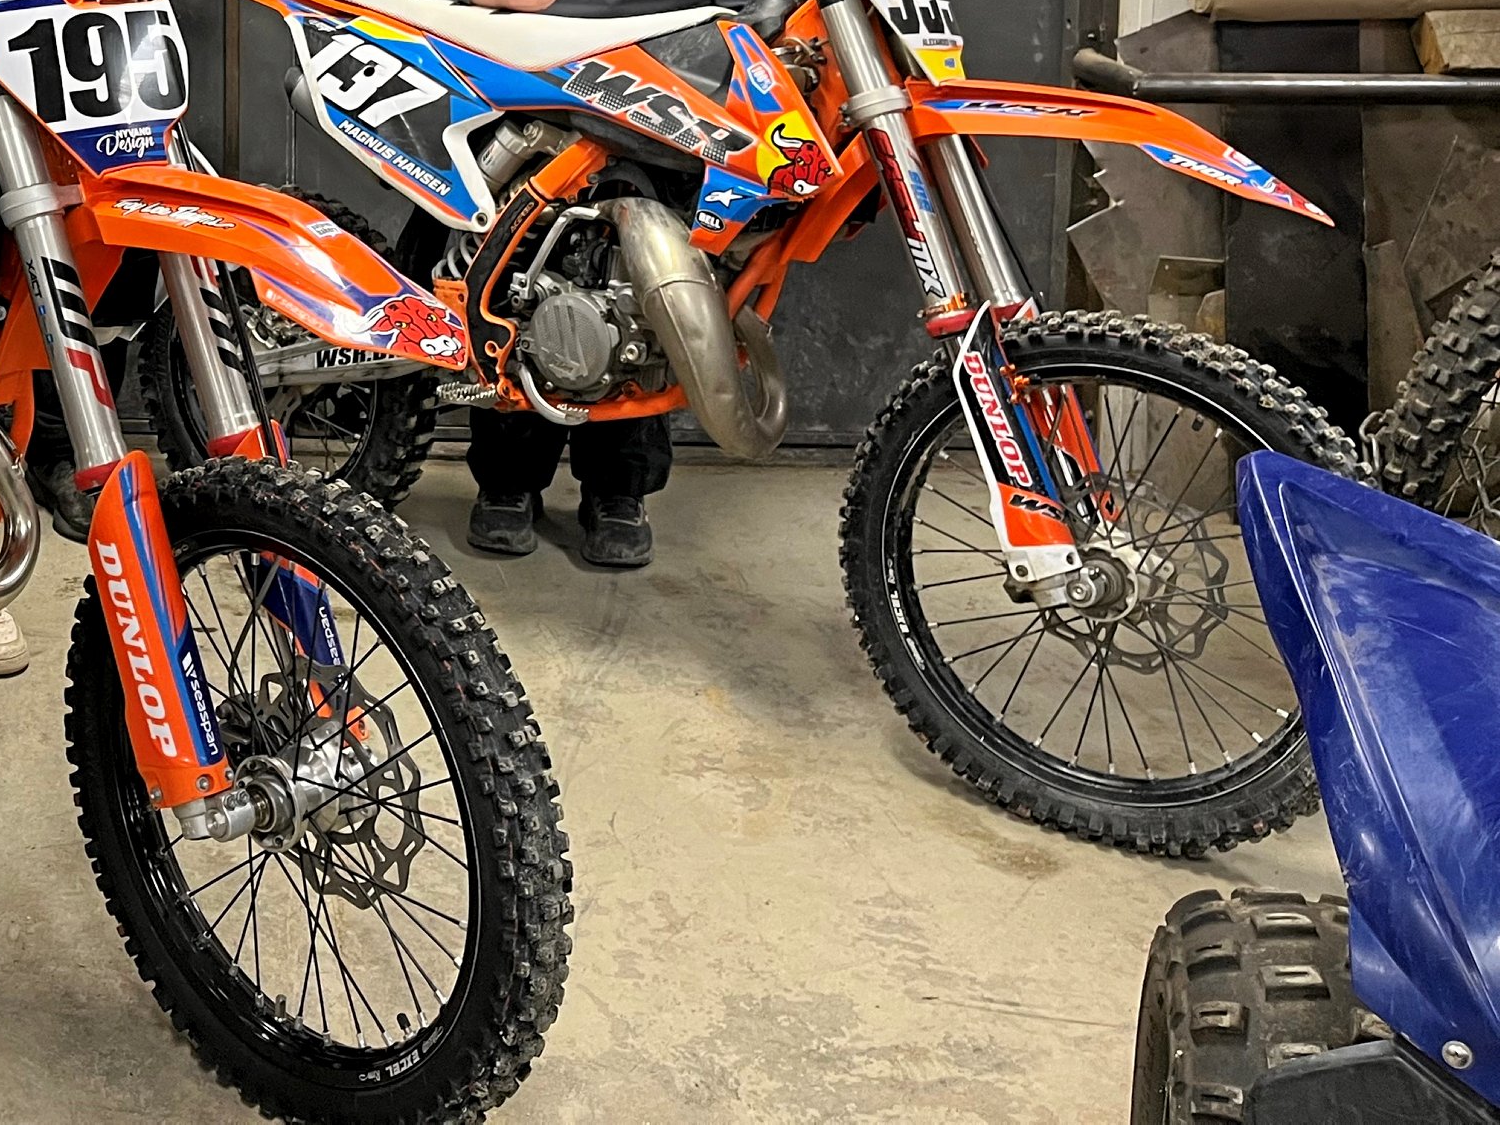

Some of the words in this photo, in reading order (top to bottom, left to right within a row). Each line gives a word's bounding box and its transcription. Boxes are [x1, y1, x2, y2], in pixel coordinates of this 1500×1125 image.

[8, 10, 187, 123] 195
[311, 34, 449, 128] 137
[96, 133, 155, 158] Design
[116, 127, 152, 138] NYVANG
[564, 60, 754, 165] WSR
[338, 120, 393, 159] MAGNUS
[393, 155, 451, 196] HANSEN
[1168, 153, 1244, 186] THOR
[696, 210, 722, 229] BELL
[26, 259, 43, 299] XACT
[963, 350, 1033, 488] DUNLOP
[96, 539, 178, 758] DUNLOP
[190, 673, 220, 756] seaspan
[385, 1049, 421, 1078] EXCEL
